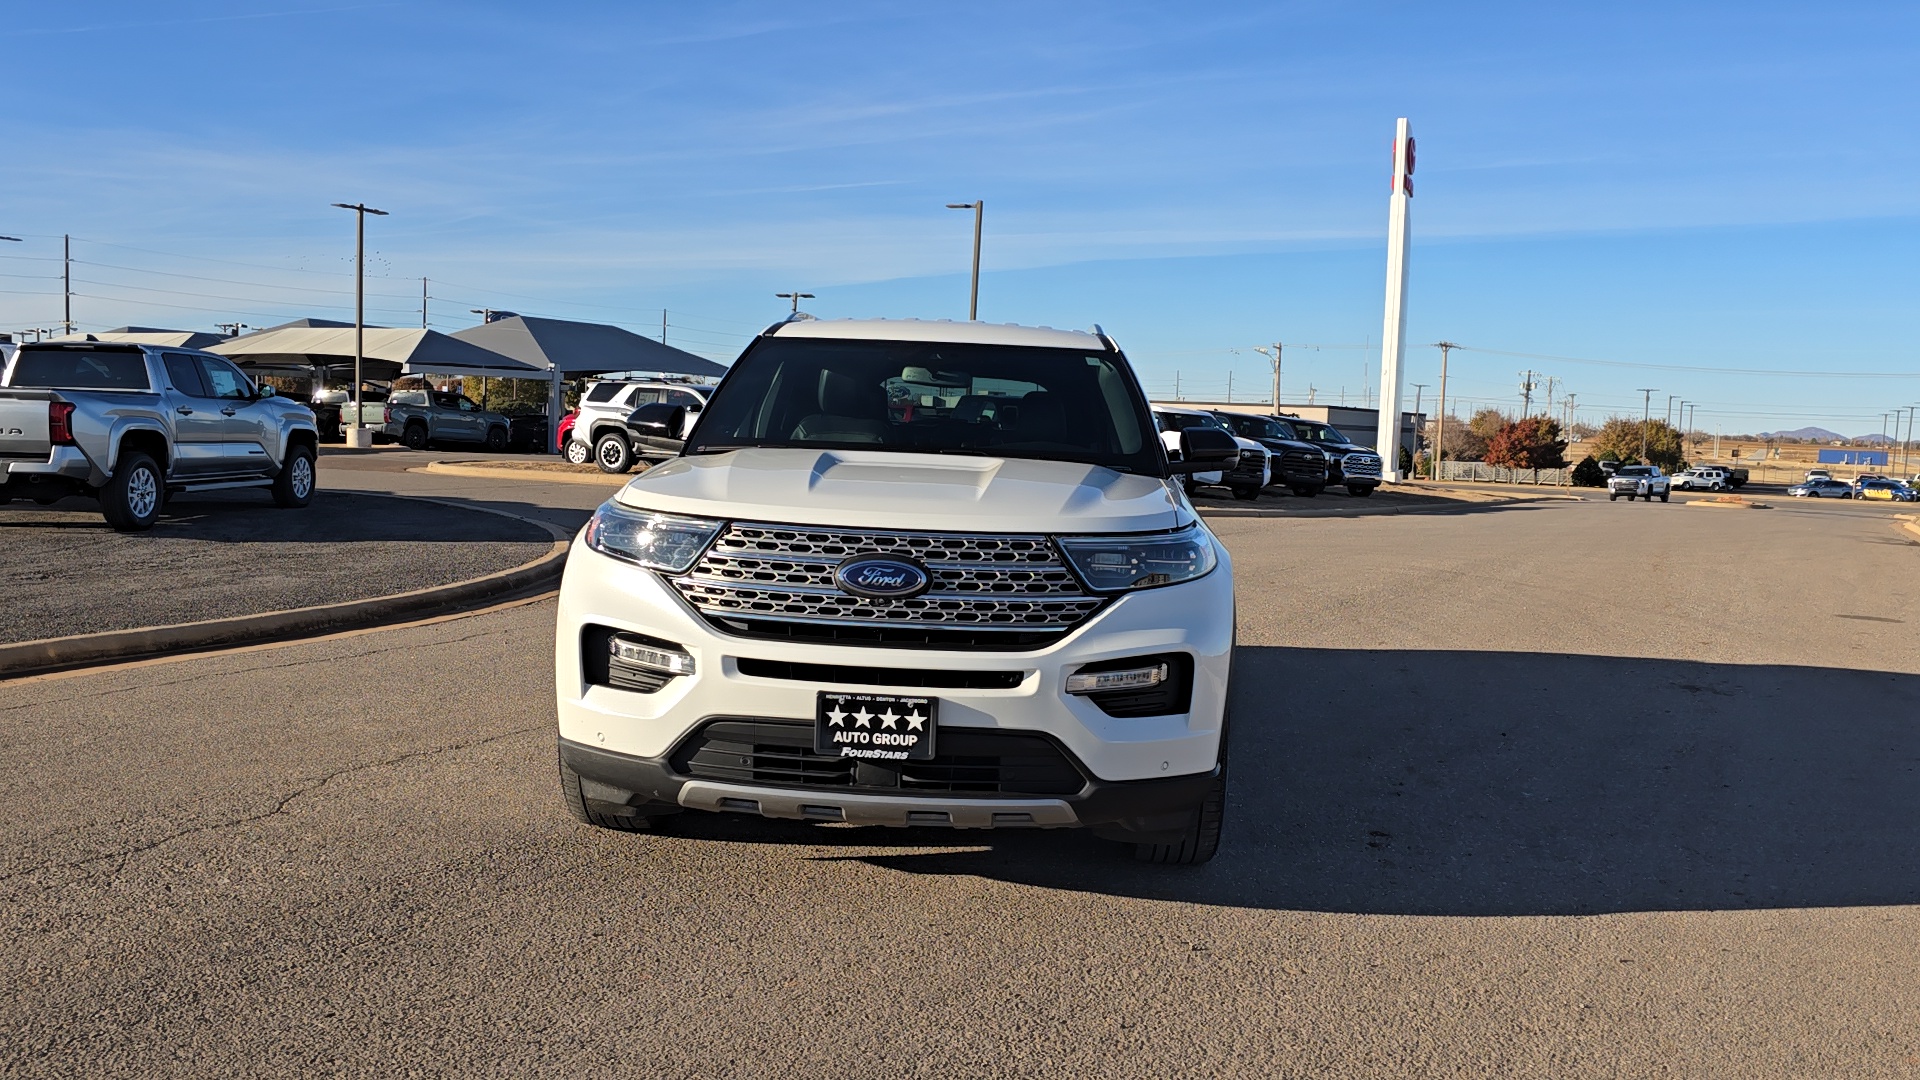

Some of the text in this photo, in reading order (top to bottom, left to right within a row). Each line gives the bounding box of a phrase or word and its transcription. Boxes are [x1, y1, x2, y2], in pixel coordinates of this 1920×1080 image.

[858, 566, 906, 587] Ford
[833, 731, 918, 746] AUTO GROUP
